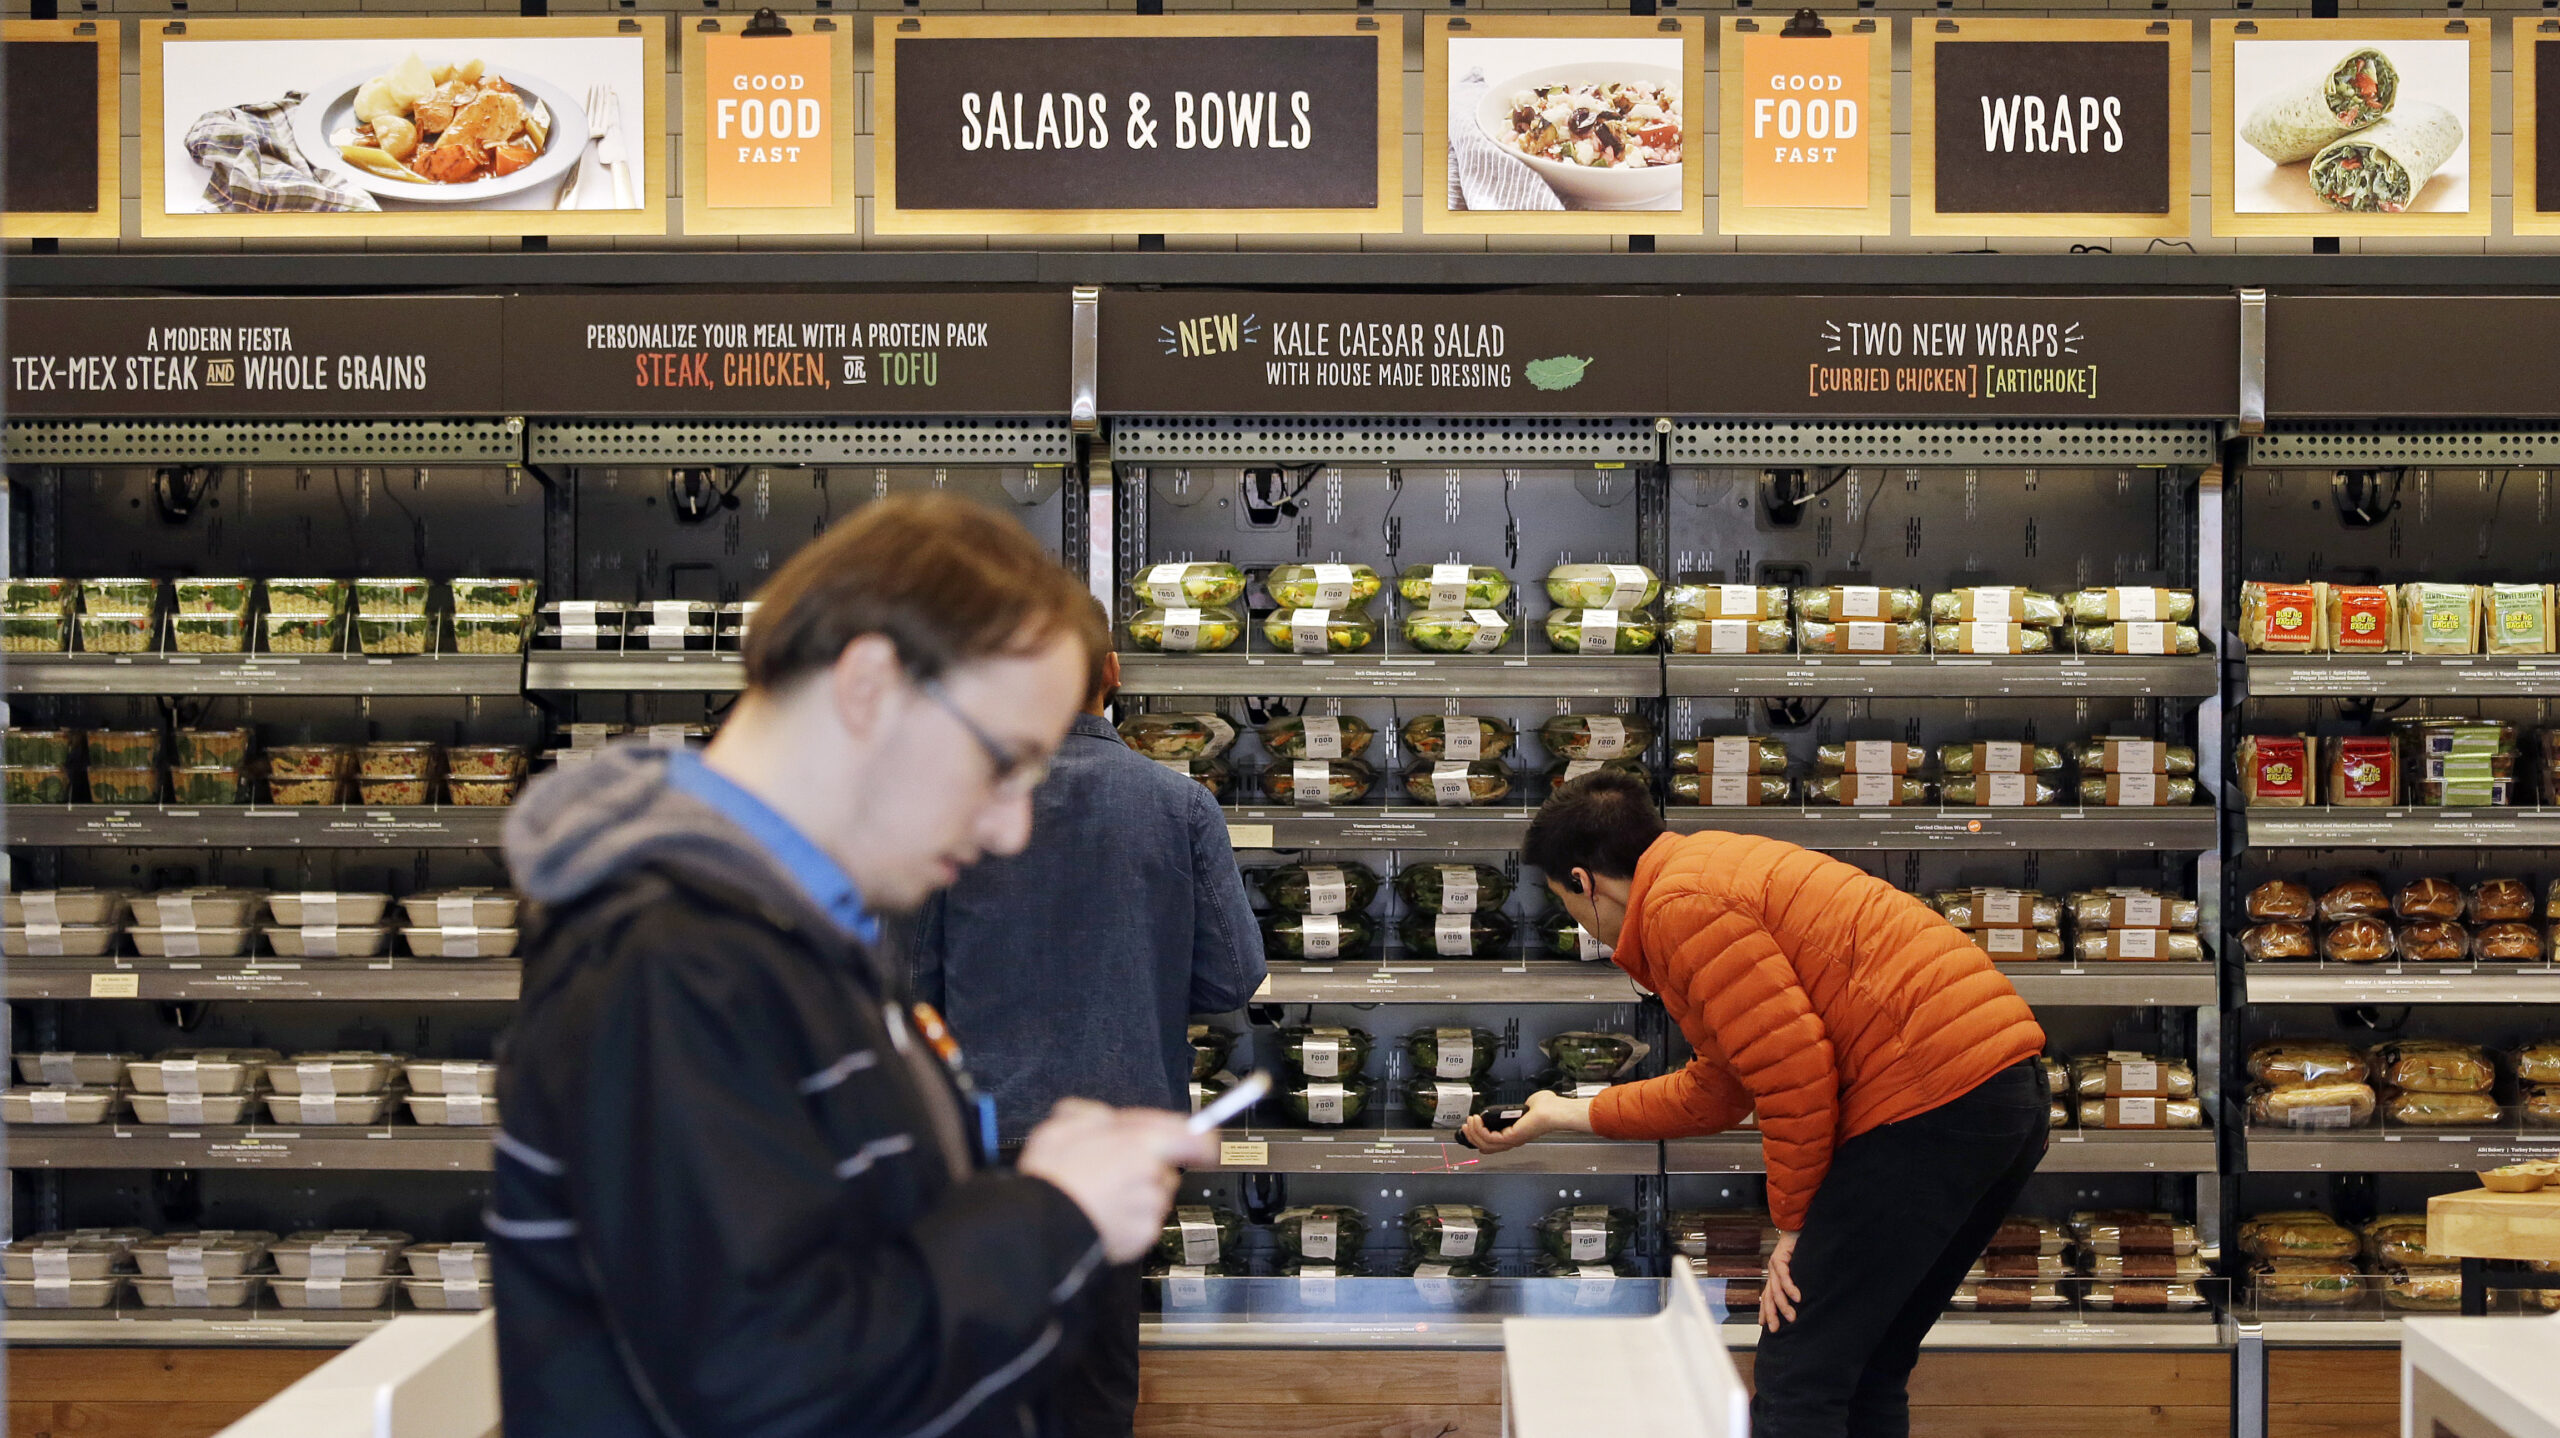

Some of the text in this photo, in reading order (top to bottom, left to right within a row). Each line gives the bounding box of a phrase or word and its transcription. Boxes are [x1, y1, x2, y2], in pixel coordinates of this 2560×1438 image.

[733, 74, 805, 91] GOOD
[1770, 74, 1843, 91] GOOD
[717, 97, 821, 140] FOOD
[961, 90, 1312, 151] SALADS & BOWLS
[1754, 98, 1858, 140] FOOD
[1980, 93, 2124, 155] WRAPS
[738, 146, 801, 163] FAST
[1774, 146, 1838, 163] FAST
[147, 326, 293, 352] A MODERN FIESTA
[587, 322, 988, 349] PERSONALIZE YOUR MEAL WITH A PROTEIN PACK
[1176, 314, 1237, 357] NEW
[1273, 321, 1505, 358] KALE CAESAR SALAD
[1847, 321, 2058, 358] TWO NEW WRAPS
[11, 354, 427, 391] TEX-MEX STEAK AND WHOLE GRAINS
[636, 351, 937, 391] STEAK, CHICKEN, OR TOFU
[1266, 361, 1512, 388] WITH HOUSE MADE DRESSING
[1809, 363, 2097, 399] [CURRIED CHICKEN] [ARTICHOKE]
[1588, 637, 1607, 645] FOOD
[1314, 736, 1333, 744] FOOD
[1597, 738, 1616, 746] FOOD
[1442, 785, 1461, 793] FOOD
[1450, 894, 1469, 902] FOOD
[1311, 939, 1331, 947] FOOD
[1443, 933, 1462, 941] FOOD
[1316, 1101, 1335, 1109] FOOD
